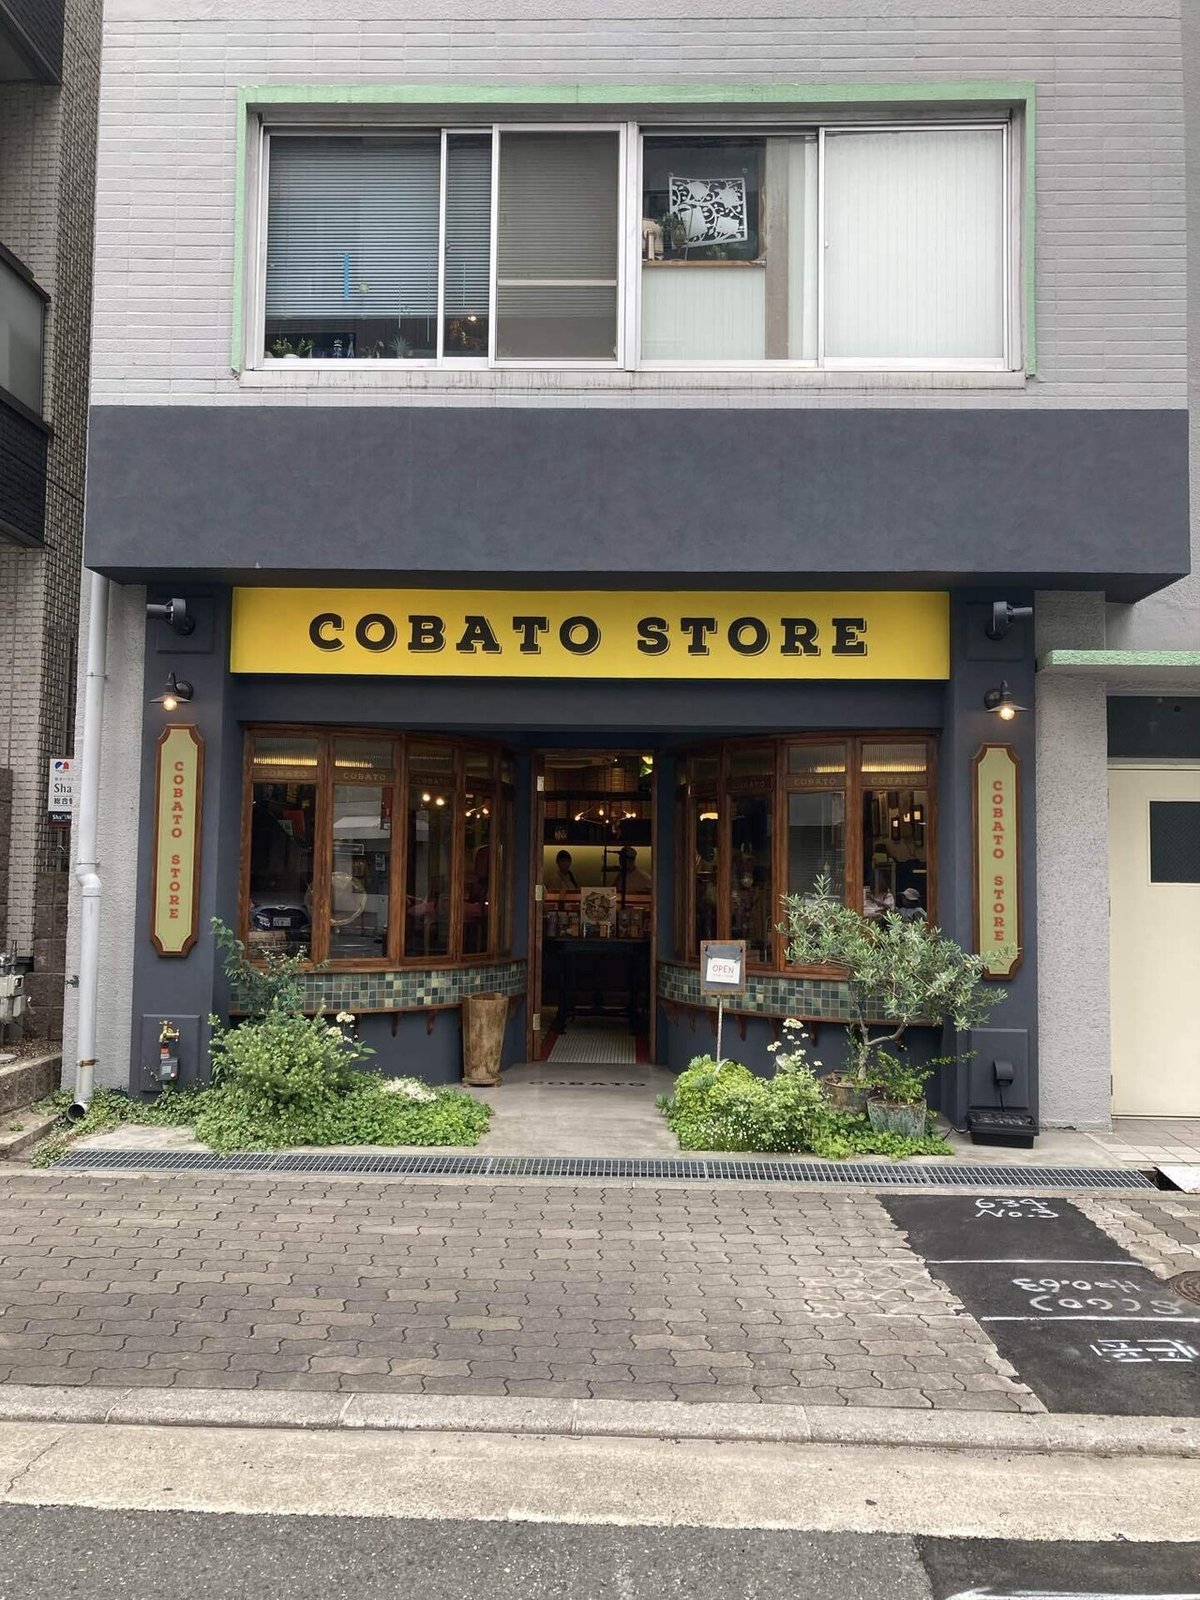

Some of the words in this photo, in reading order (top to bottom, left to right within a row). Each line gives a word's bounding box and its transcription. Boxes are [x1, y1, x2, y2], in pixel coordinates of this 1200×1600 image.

[308, 612, 602, 656] COBATO
[636, 616, 869, 657] STORE
[343, 772, 386, 781] COBATO
[171, 761, 184, 838] COBATO
[992, 781, 1005, 859] COBATO
[169, 855, 181, 919] STORE
[993, 876, 1005, 941] STORE
[712, 964, 735, 974] OPEN
[975, 1198, 1049, 1209] 634
[975, 1208, 1059, 1218] No.3
